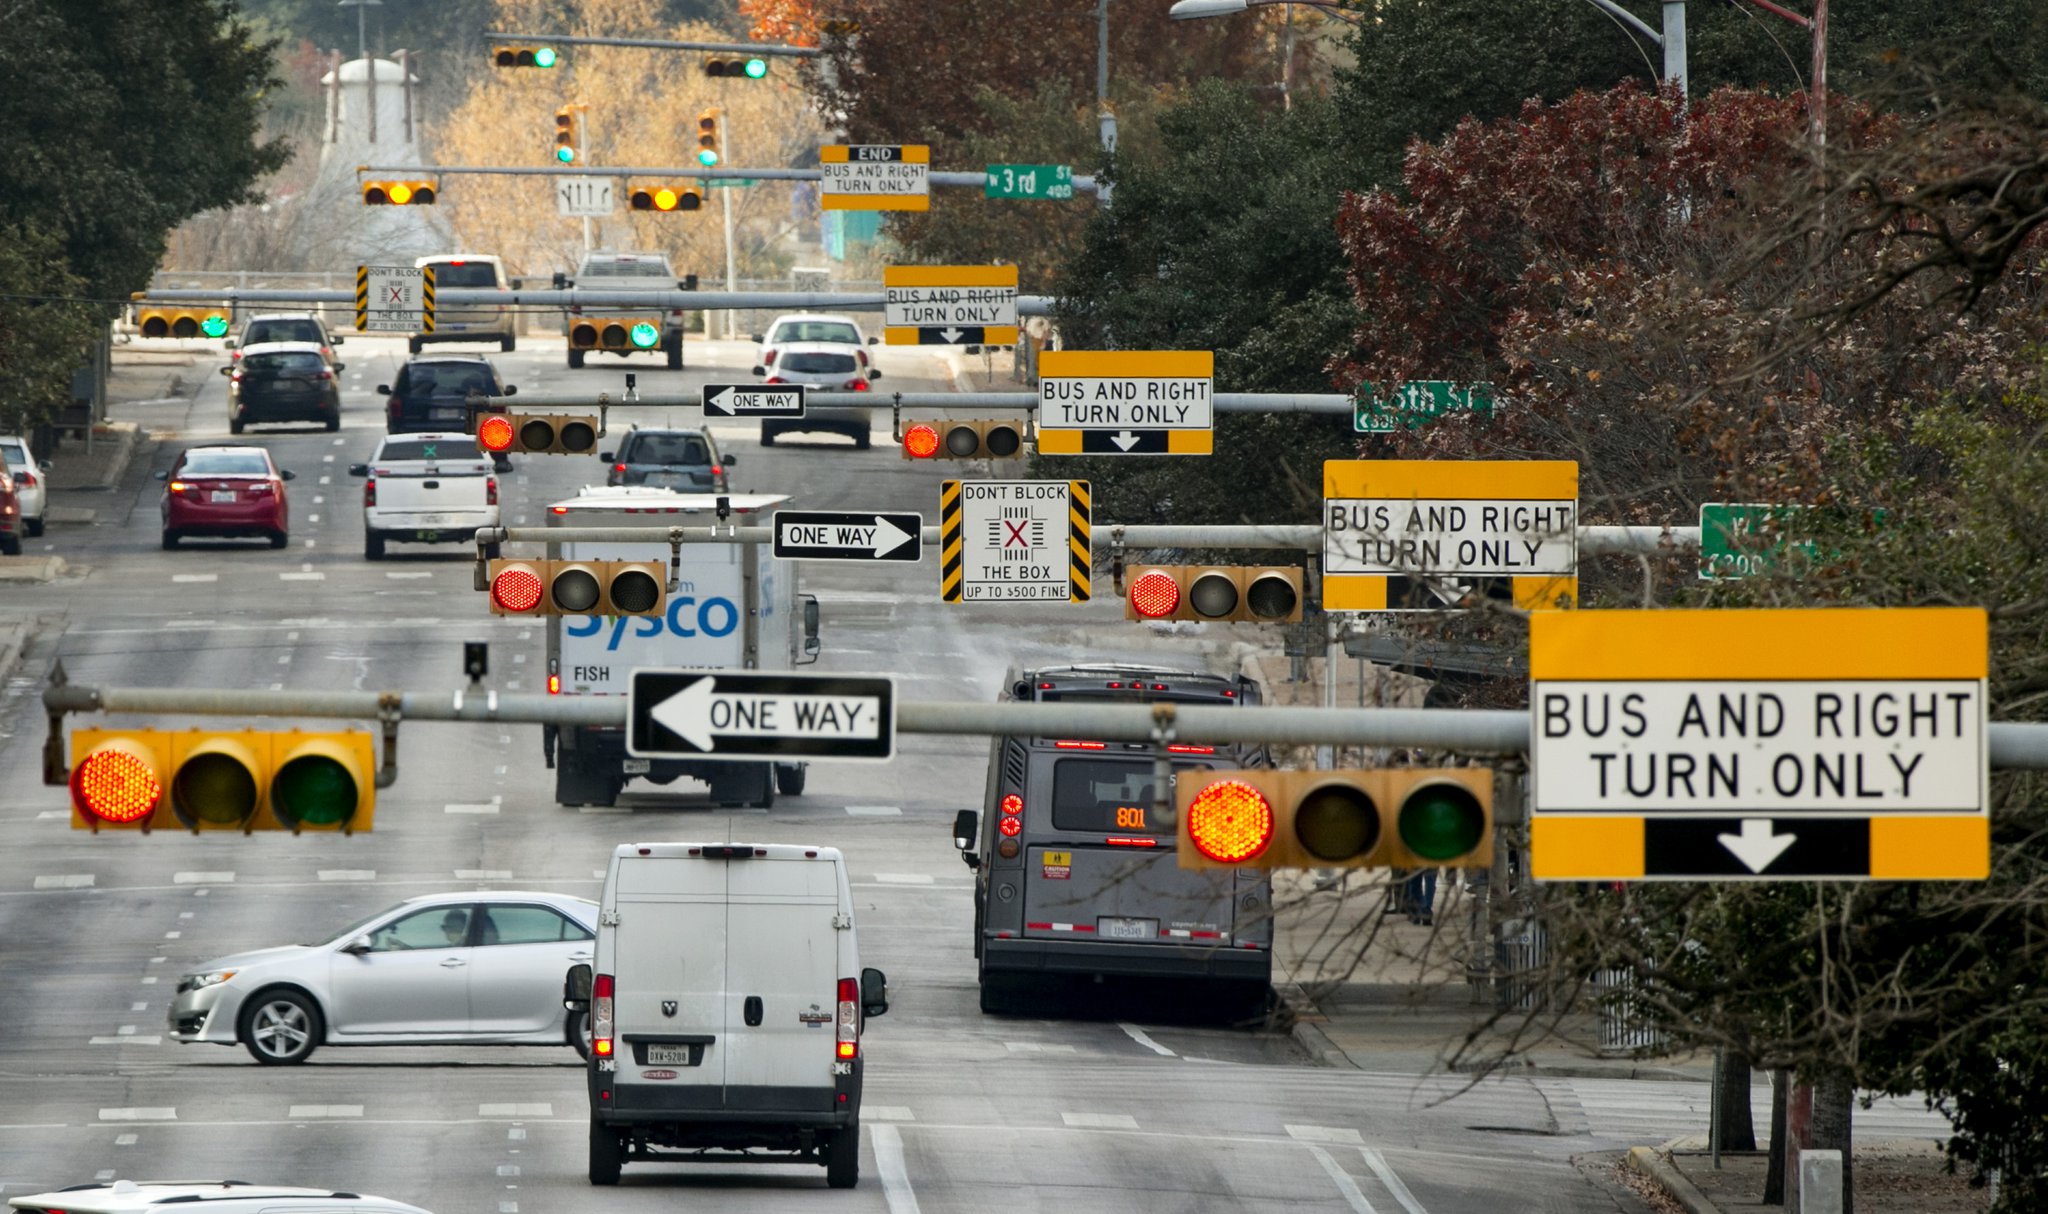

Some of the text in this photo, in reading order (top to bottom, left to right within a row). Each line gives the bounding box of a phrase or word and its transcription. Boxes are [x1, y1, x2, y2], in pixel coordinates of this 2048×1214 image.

[858, 148, 892, 160] END
[824, 165, 925, 177] BUS AND RIGHT
[835, 180, 915, 192] TURN ONLY
[1003, 168, 1036, 194] 3rd
[396, 269, 423, 277] BLOCK
[888, 289, 1013, 304] BUS AND RIGHT
[377, 311, 392, 319] THE
[902, 308, 1000, 322] TURN ONLY
[1044, 382, 1207, 400] BUS AND RIGHT
[733, 395, 793, 407] ONE WAY
[1062, 405, 1189, 423] TURN ONLY
[965, 487, 1066, 500] DON'T BLOCK
[1331, 506, 1570, 533] BUS AND RIGHT
[789, 526, 876, 546] ONE WAY
[1357, 540, 1544, 566] TURN ONLY
[982, 566, 1051, 579] THE BOX
[966, 586, 1066, 598] UP TO $500 FINE
[574, 665, 610, 682] FISH
[710, 699, 863, 731] ONE WAY
[1543, 693, 1971, 738] BUS AND RIGHT
[1590, 753, 1924, 798] TURN ONLY
[1117, 807, 1145, 828] 801
